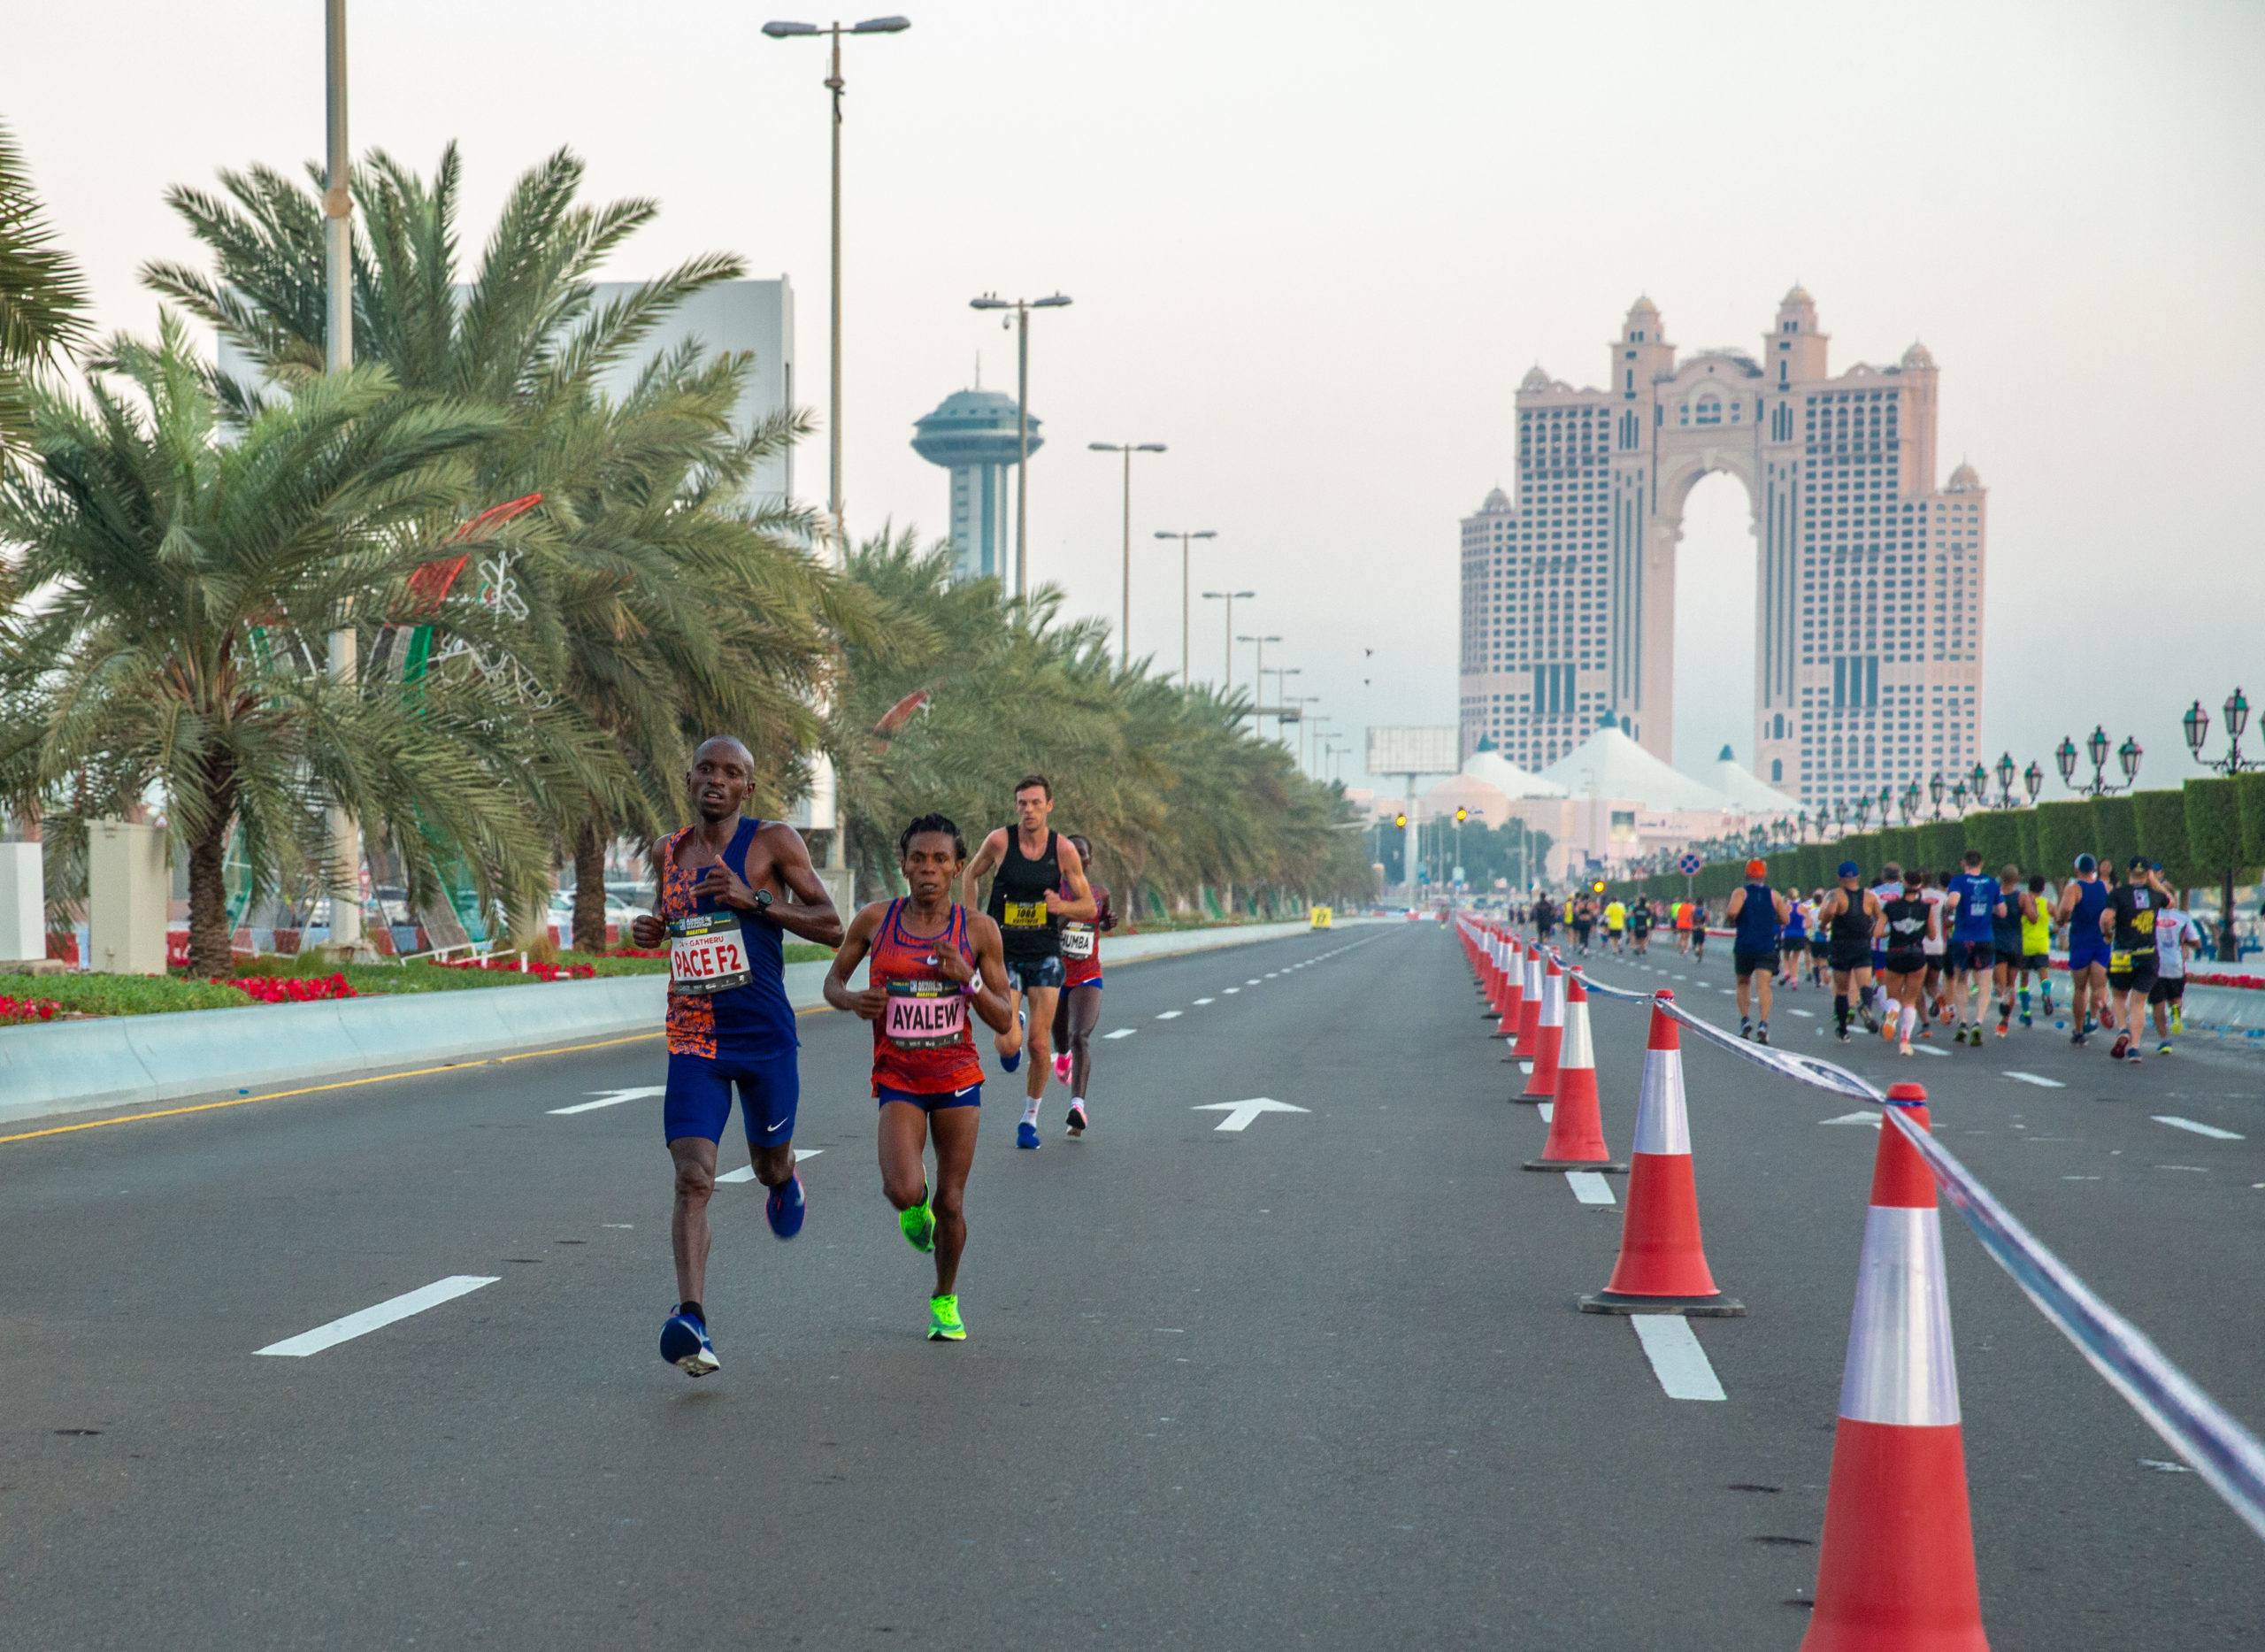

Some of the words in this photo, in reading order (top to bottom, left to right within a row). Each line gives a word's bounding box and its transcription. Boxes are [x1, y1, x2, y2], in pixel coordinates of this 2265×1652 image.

[689, 935, 724, 946] GATHERU
[674, 948, 715, 978] PACE
[716, 943, 741, 972] F2
[892, 1003, 960, 1030] AYALEW
